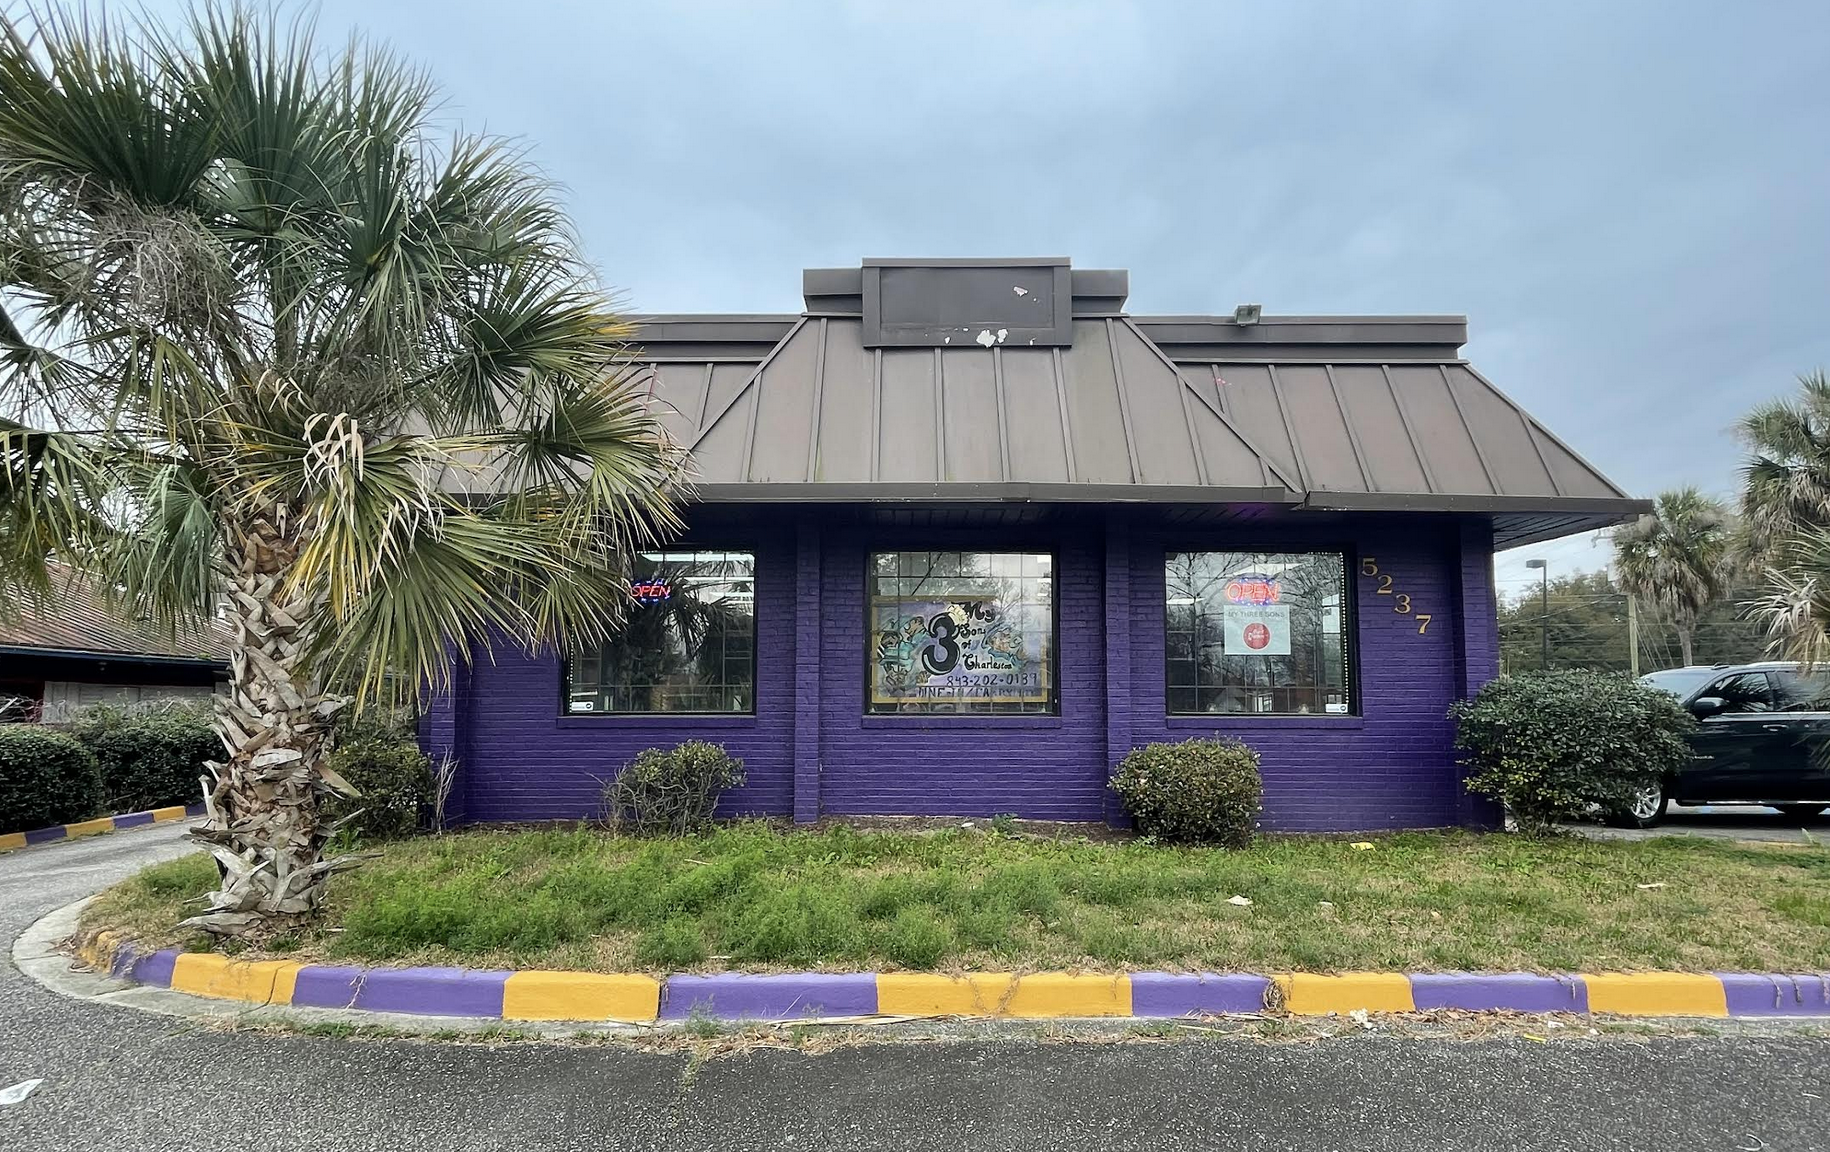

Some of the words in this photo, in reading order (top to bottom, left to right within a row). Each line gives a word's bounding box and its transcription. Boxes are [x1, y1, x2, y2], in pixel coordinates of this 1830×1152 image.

[631, 585, 671, 598] OPEN
[1227, 583, 1280, 602] OPEN
[1361, 557, 1432, 634] 5237
[951, 601, 996, 623] My
[1240, 610, 1263, 618] THREE
[1264, 610, 1286, 618] SONS
[921, 612, 960, 676] 3
[961, 640, 972, 649] of
[962, 653, 1013, 671] Charleston
